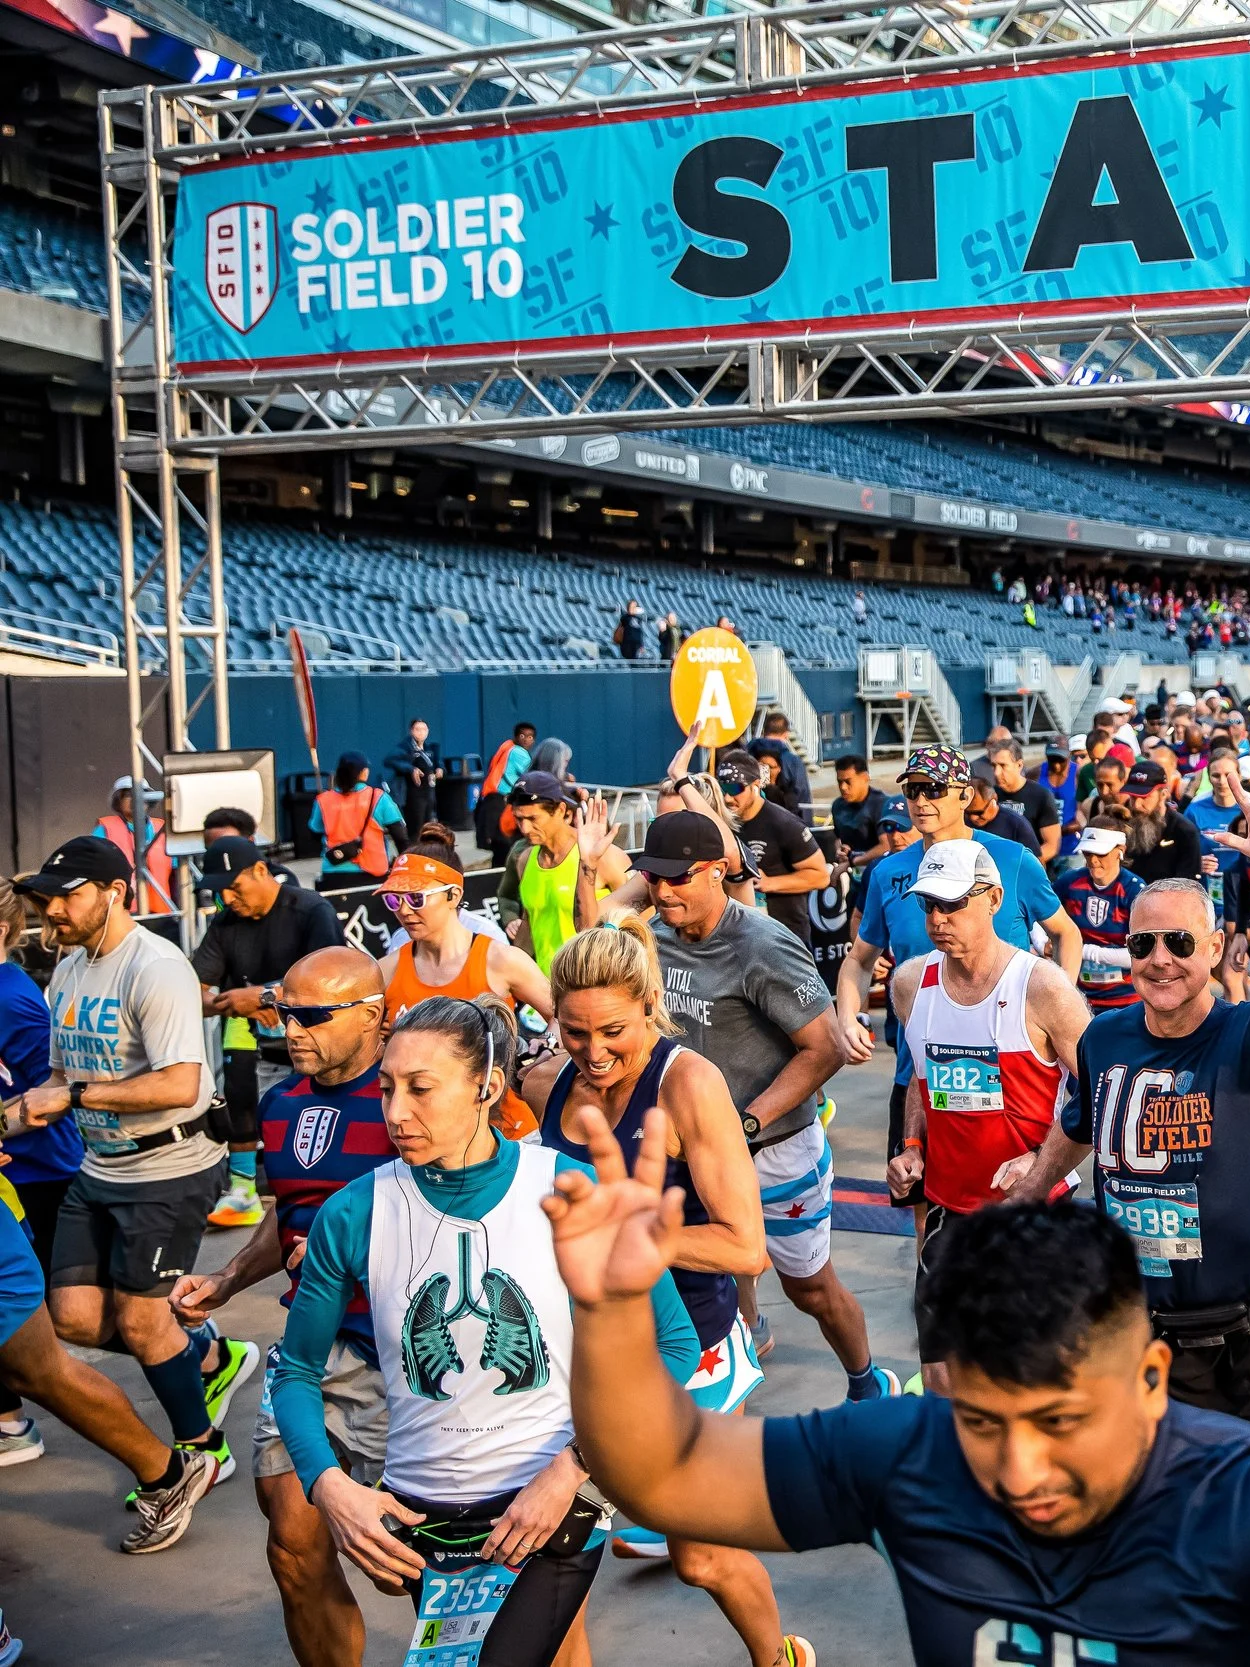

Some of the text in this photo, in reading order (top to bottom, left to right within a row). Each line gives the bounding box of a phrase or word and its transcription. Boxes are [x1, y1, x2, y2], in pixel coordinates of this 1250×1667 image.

[779, 117, 834, 193] SF
[515, 150, 568, 213] 10
[819, 175, 881, 240] 10
[291, 192, 527, 263] SOLDIER
[217, 223, 236, 298] SF10
[961, 210, 1028, 288] SF
[297, 247, 524, 314] FIELD 10
[522, 248, 576, 317] SF
[635, 450, 686, 475] UNITED
[744, 467, 768, 493] PNC
[940, 501, 1018, 532] SOLDIER FIELD
[687, 647, 742, 663] CORRAL
[694, 669, 736, 730] A
[928, 863, 945, 871] OR
[666, 967, 693, 994] VITAL
[58, 1034, 119, 1055] OUNTRY
[65, 1055, 123, 1071] ALLENGE
[932, 1066, 981, 1089] 1282
[936, 1094, 946, 1107] A
[1143, 1098, 1213, 1126] SOLDIER
[300, 1115, 315, 1149] SF10
[1143, 1124, 1212, 1150] FIELD
[1173, 1152, 1203, 1163] MILE
[1121, 1184, 1153, 1194] SOLDIER
[424, 1575, 498, 1615] 2355
[420, 1623, 436, 1645] A
[444, 1621, 459, 1630] Lisa
